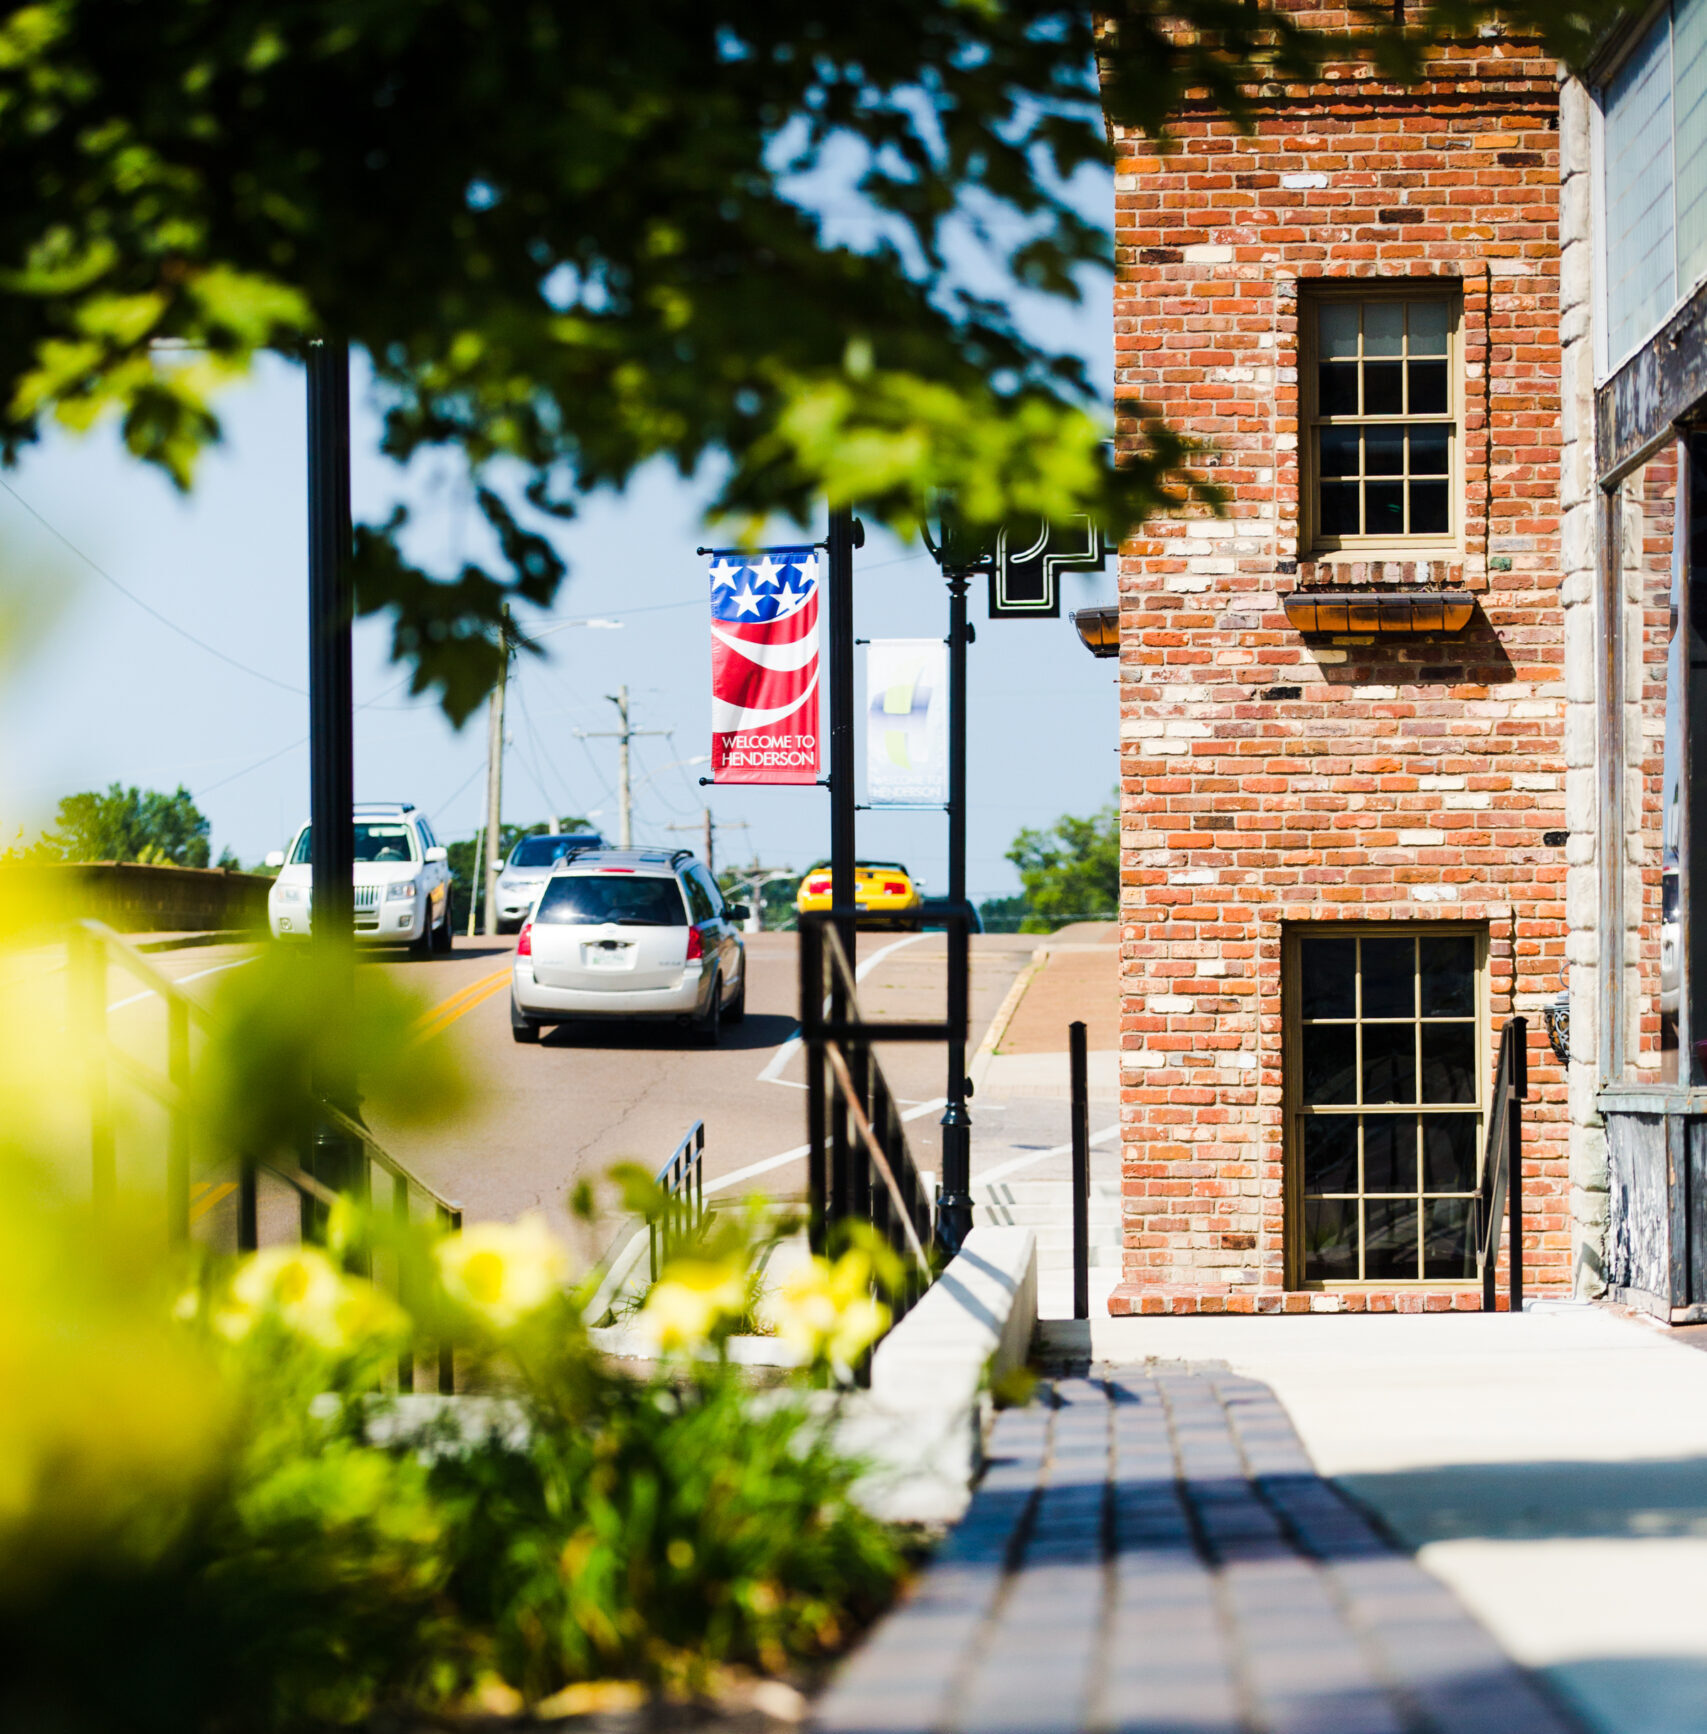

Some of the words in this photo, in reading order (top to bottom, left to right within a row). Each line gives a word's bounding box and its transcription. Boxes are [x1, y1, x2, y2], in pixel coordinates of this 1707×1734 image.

[722, 735, 792, 748] WELCOME
[795, 735, 815, 748] TO
[722, 751, 814, 766] HENDERSON
